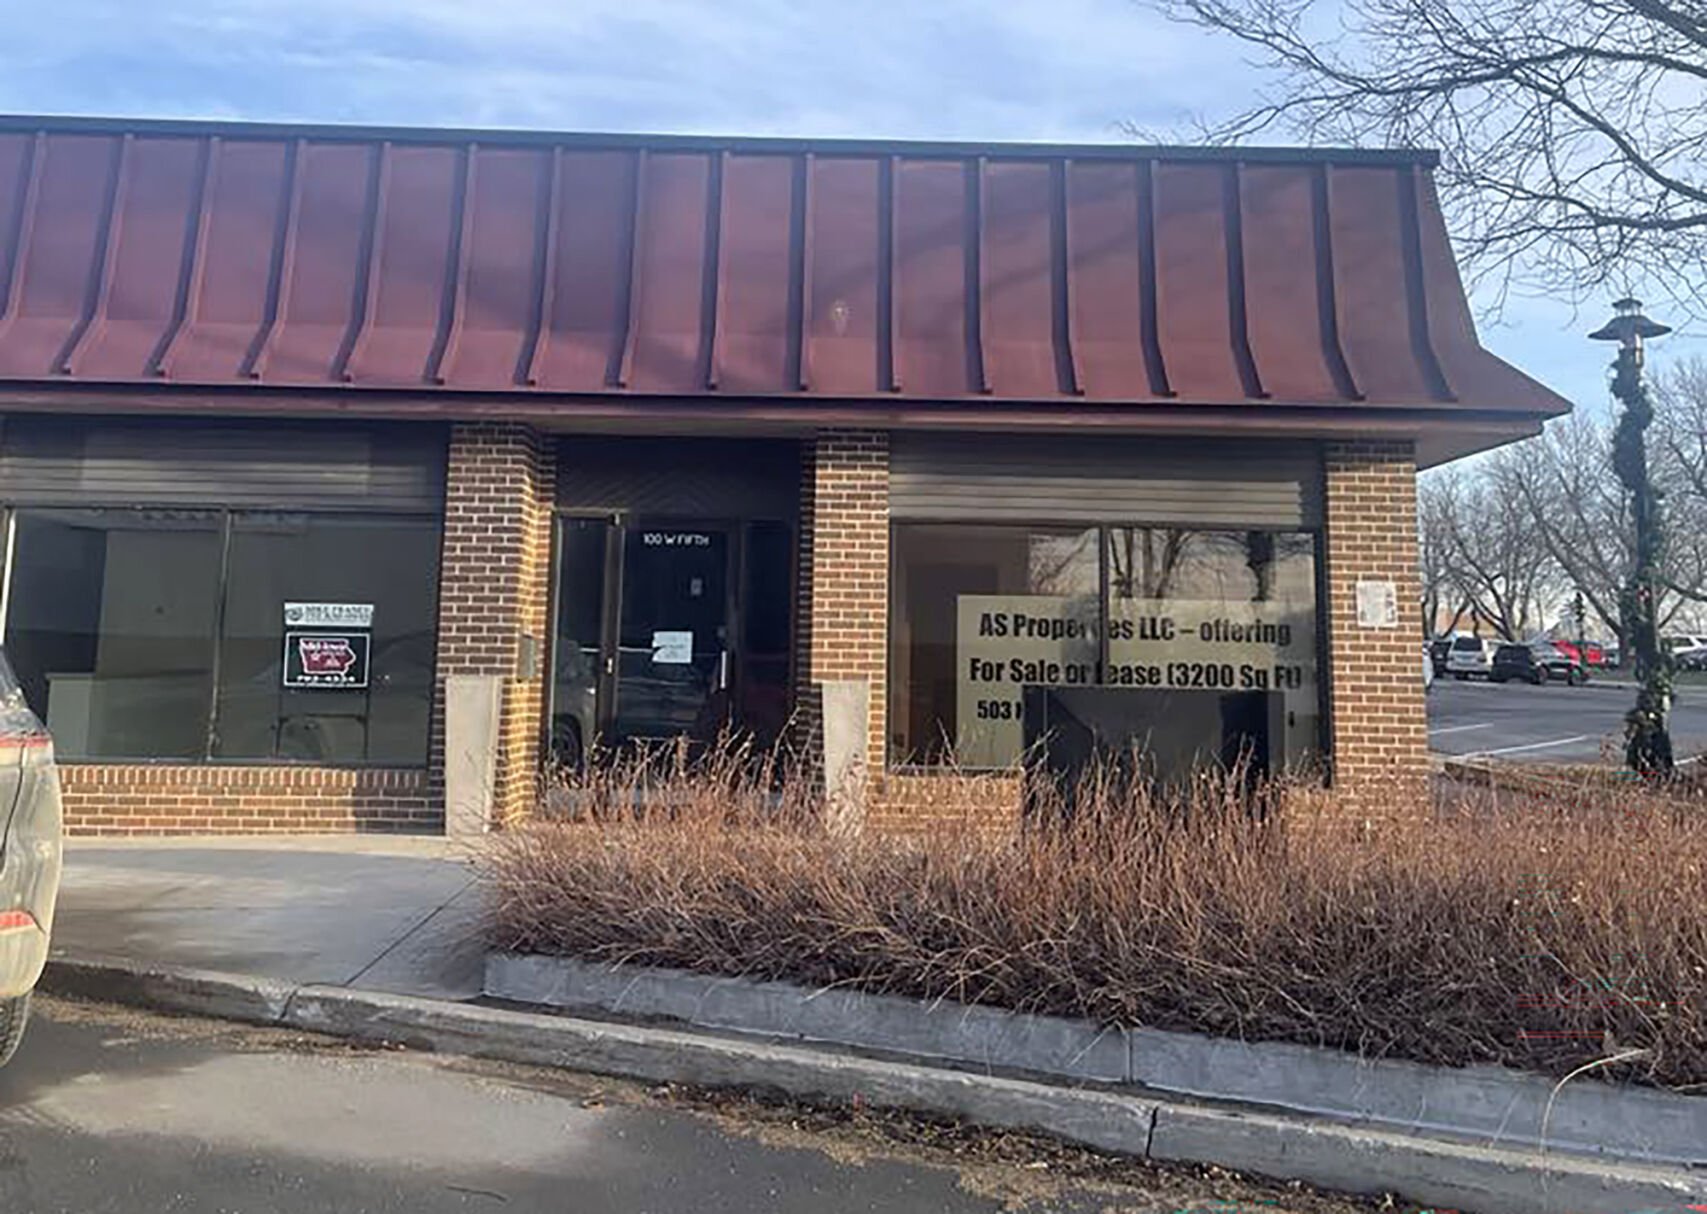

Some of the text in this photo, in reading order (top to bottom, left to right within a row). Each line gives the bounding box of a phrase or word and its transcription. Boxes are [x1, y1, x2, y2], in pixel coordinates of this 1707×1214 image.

[643, 532, 710, 546] 100 W FIFTH
[979, 613, 1008, 637] AS
[1139, 617, 1174, 641] LLC
[1200, 618, 1292, 646] offering
[970, 658, 1004, 682] For
[1010, 658, 1060, 683] Sale
[1065, 663, 1090, 684] or
[1167, 663, 1235, 687] (3200
[1240, 664, 1269, 689] Sq
[977, 700, 1011, 720] 503
